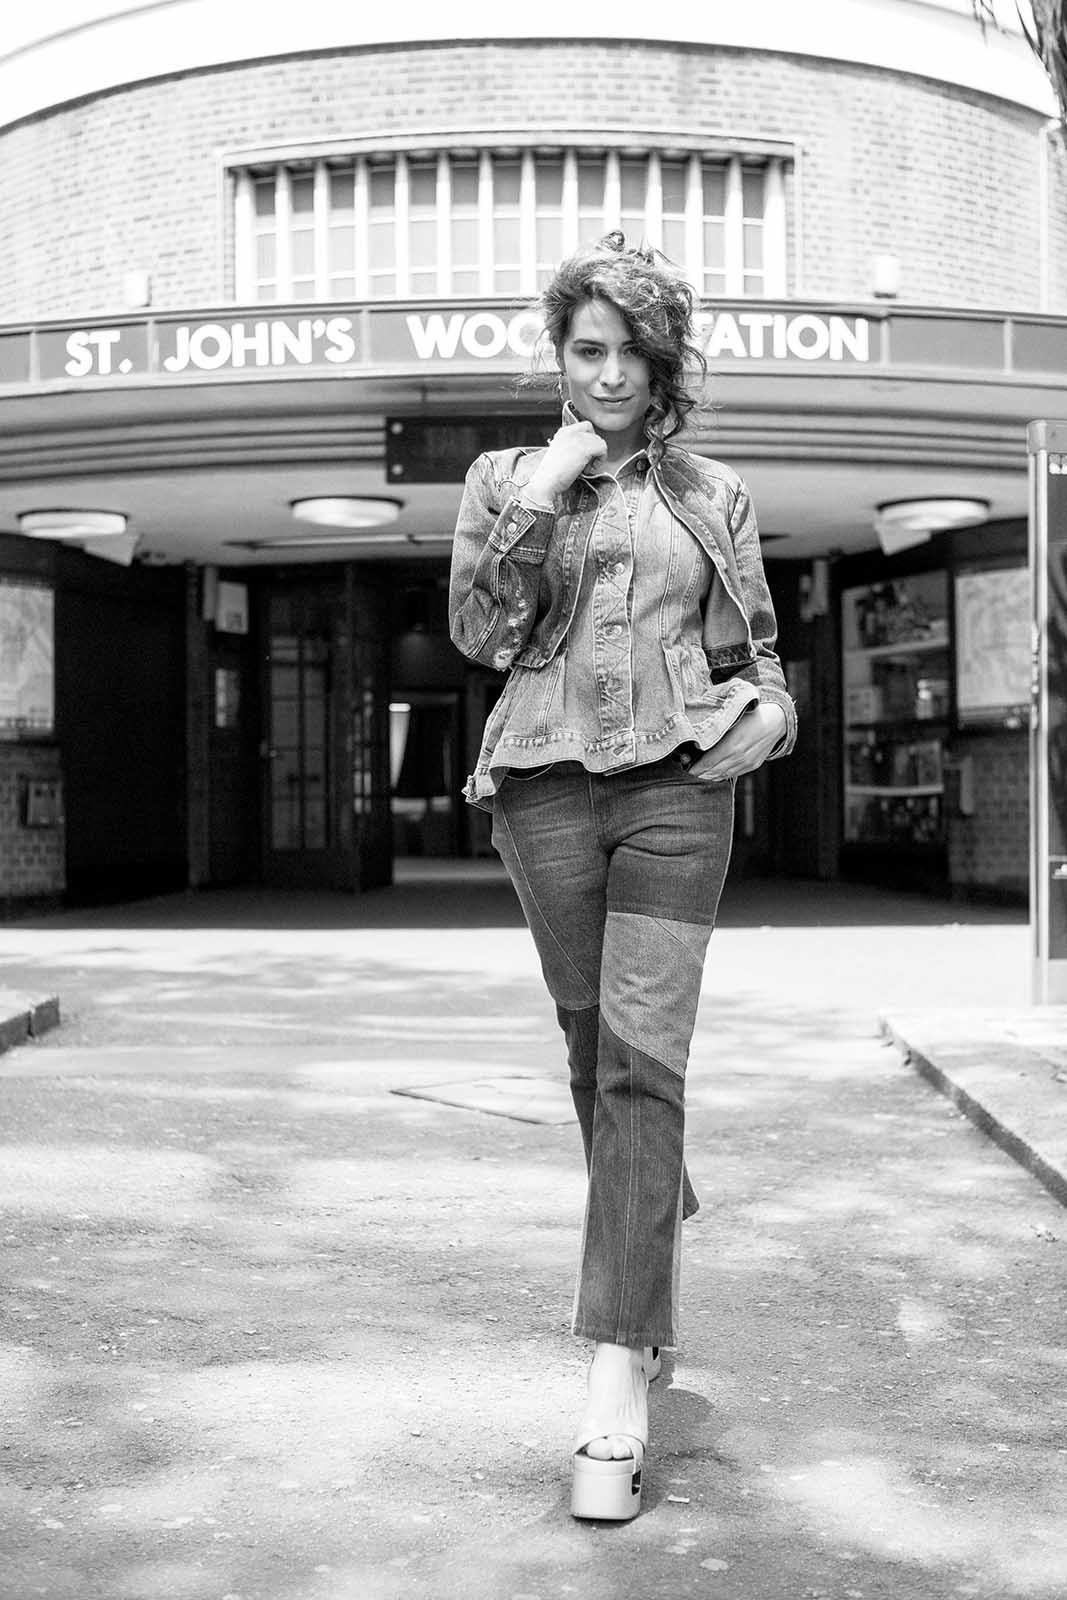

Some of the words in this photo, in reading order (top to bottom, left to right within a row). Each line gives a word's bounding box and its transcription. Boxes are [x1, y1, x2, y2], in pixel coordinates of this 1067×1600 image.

[64, 330, 133, 377] ST.
[163, 317, 355, 371] JOHN'S
[405, 312, 546, 359] WOO
[692, 312, 870, 361] ATION
